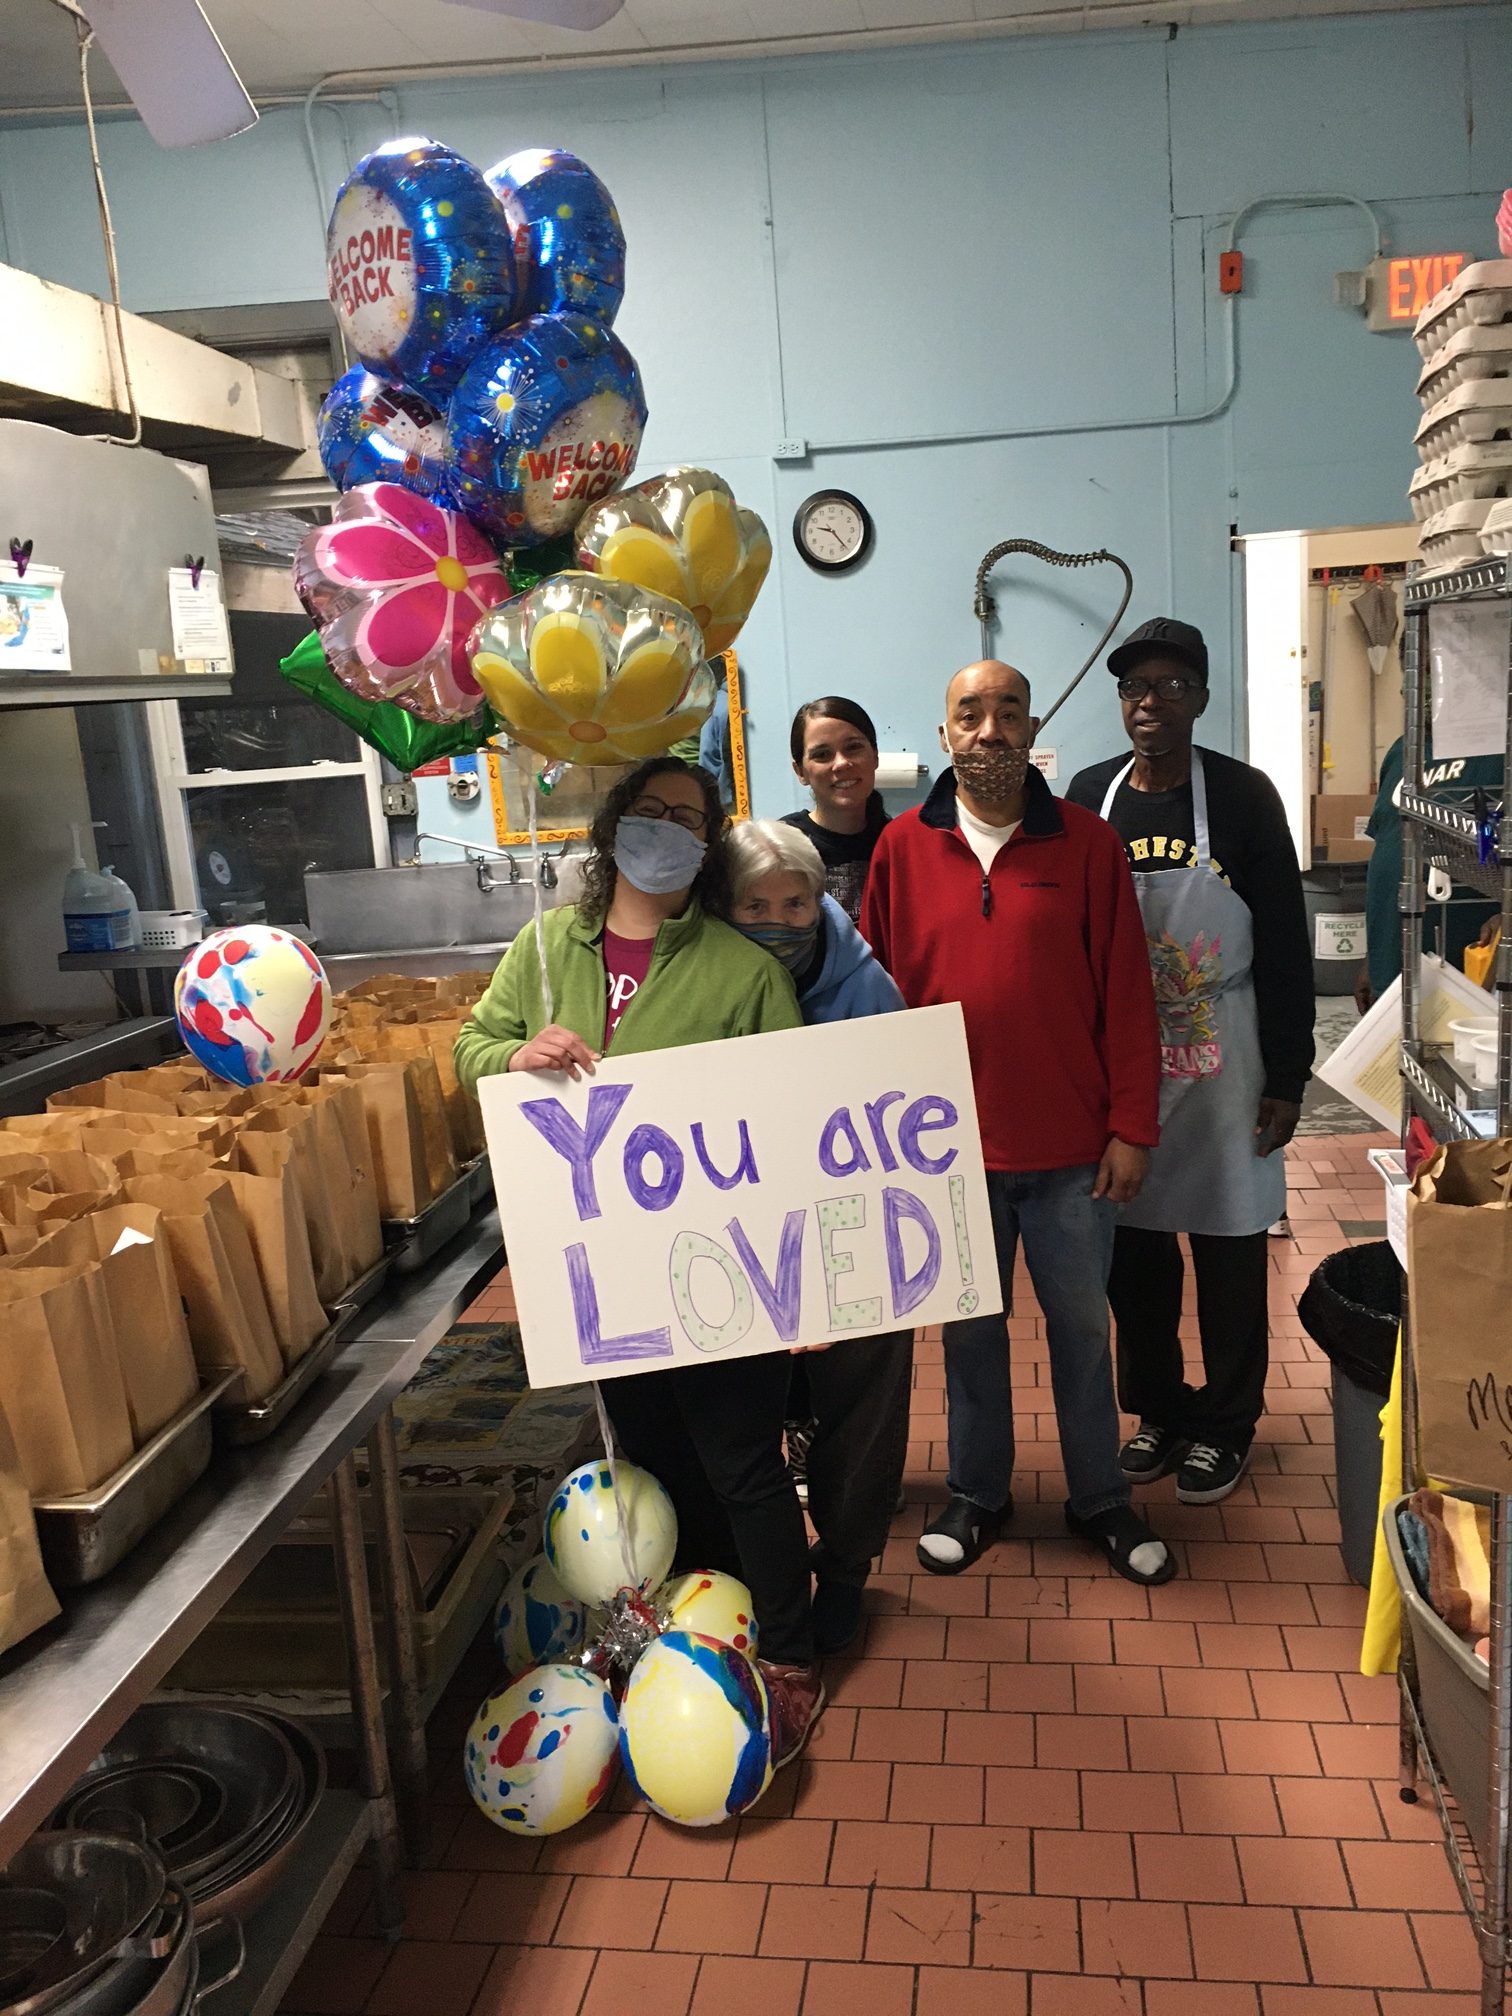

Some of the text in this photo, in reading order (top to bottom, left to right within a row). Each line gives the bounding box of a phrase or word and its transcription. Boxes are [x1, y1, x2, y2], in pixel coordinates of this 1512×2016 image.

[341, 266, 395, 317] BACK
[1333, 930, 1358, 938] HERE
[518, 1083, 959, 1221] You are
[562, 1174, 981, 1366] LOVED!
